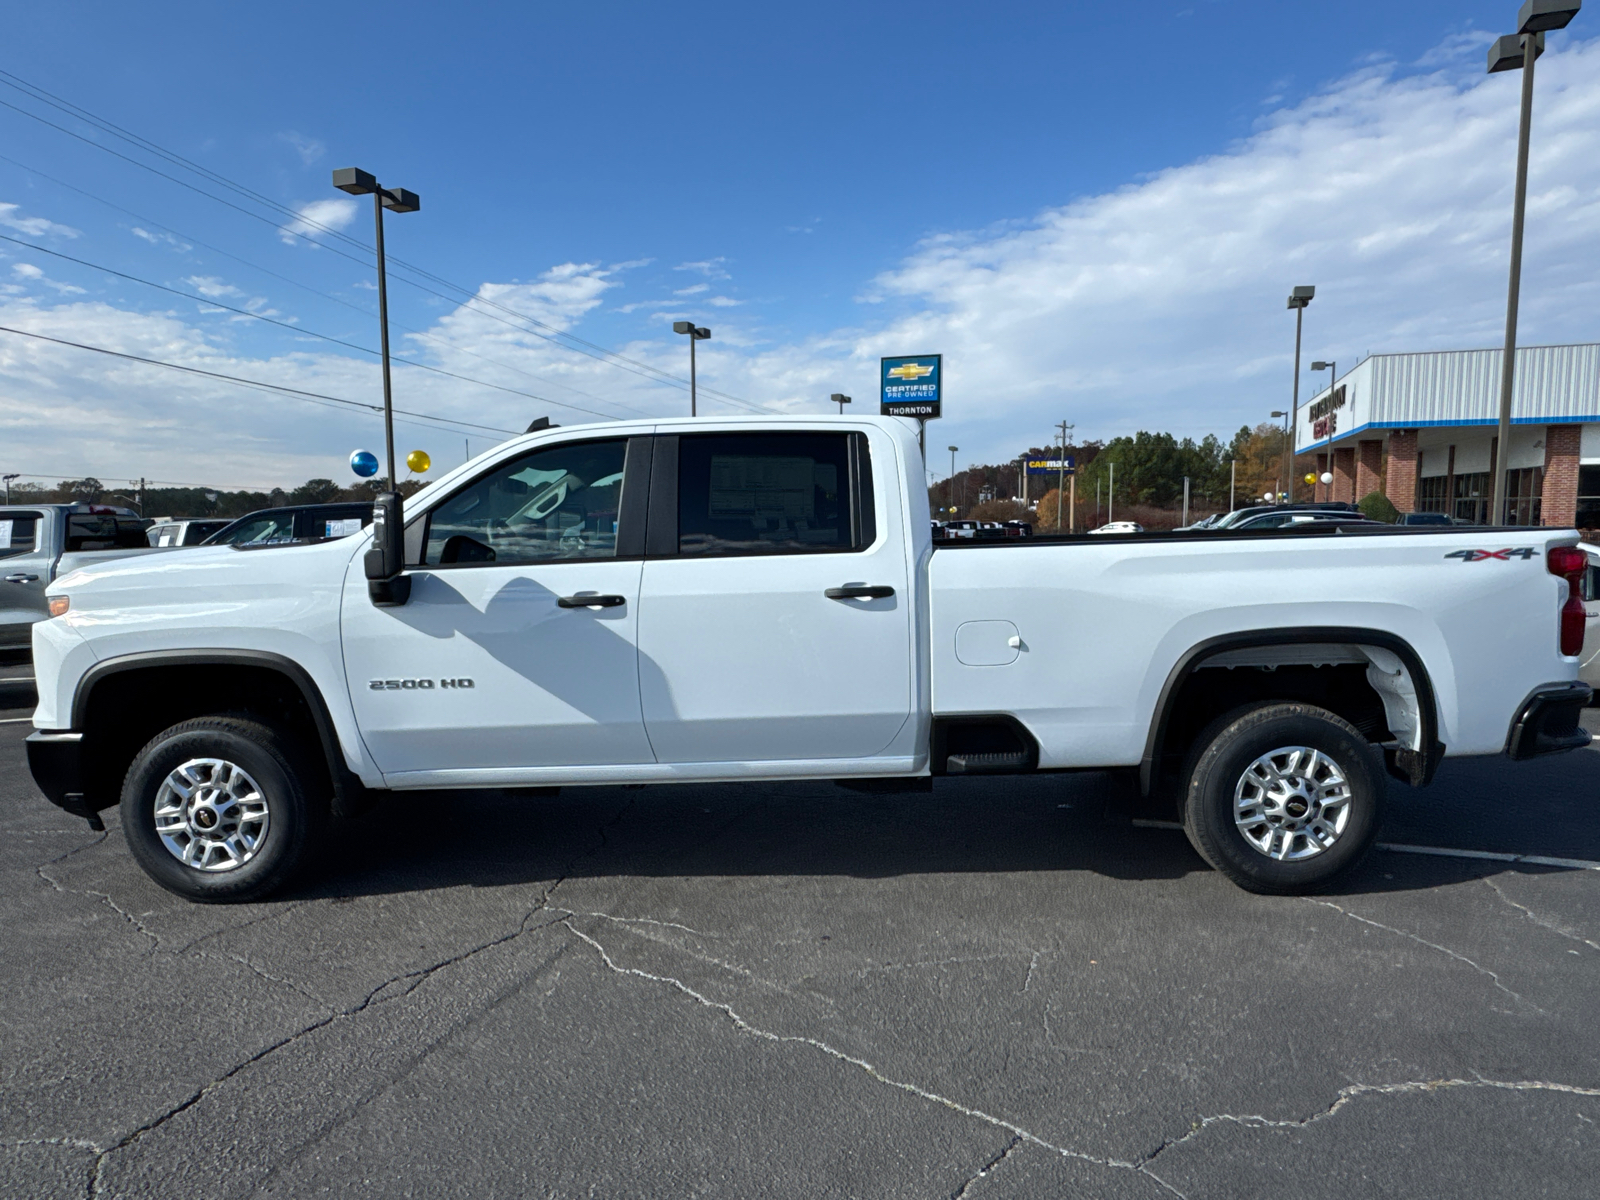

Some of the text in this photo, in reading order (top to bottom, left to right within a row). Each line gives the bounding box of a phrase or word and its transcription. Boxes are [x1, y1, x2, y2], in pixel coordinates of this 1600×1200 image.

[885, 384, 936, 393] CERTIFIED
[888, 406, 932, 415] THORNTON
[369, 679, 475, 690] 2500 HD
